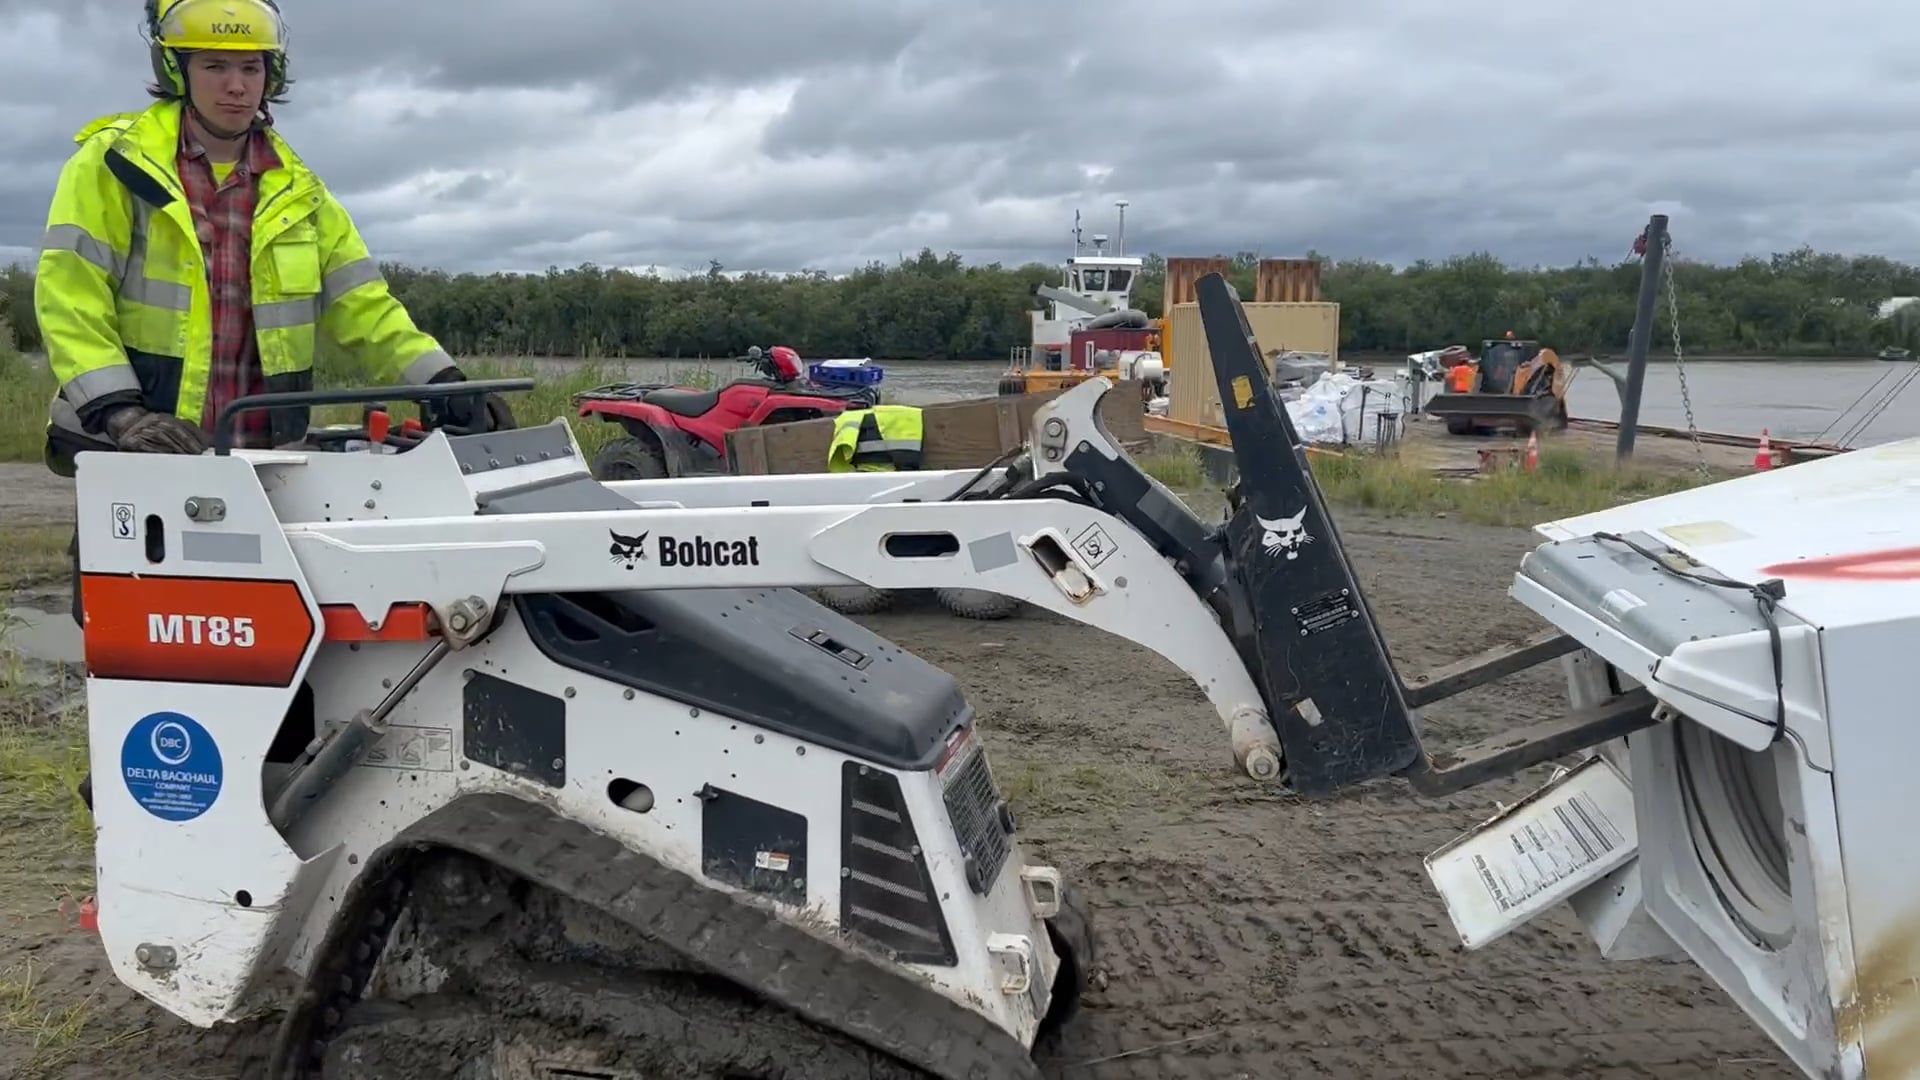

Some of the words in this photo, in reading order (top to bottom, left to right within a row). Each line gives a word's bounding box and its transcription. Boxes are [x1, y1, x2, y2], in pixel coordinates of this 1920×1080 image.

[658, 535, 760, 567] Bobcat
[148, 613, 255, 648] MT85
[160, 737, 183, 749] DBC
[127, 767, 160, 780] DELTA
[161, 769, 218, 785] BACKHAUL
